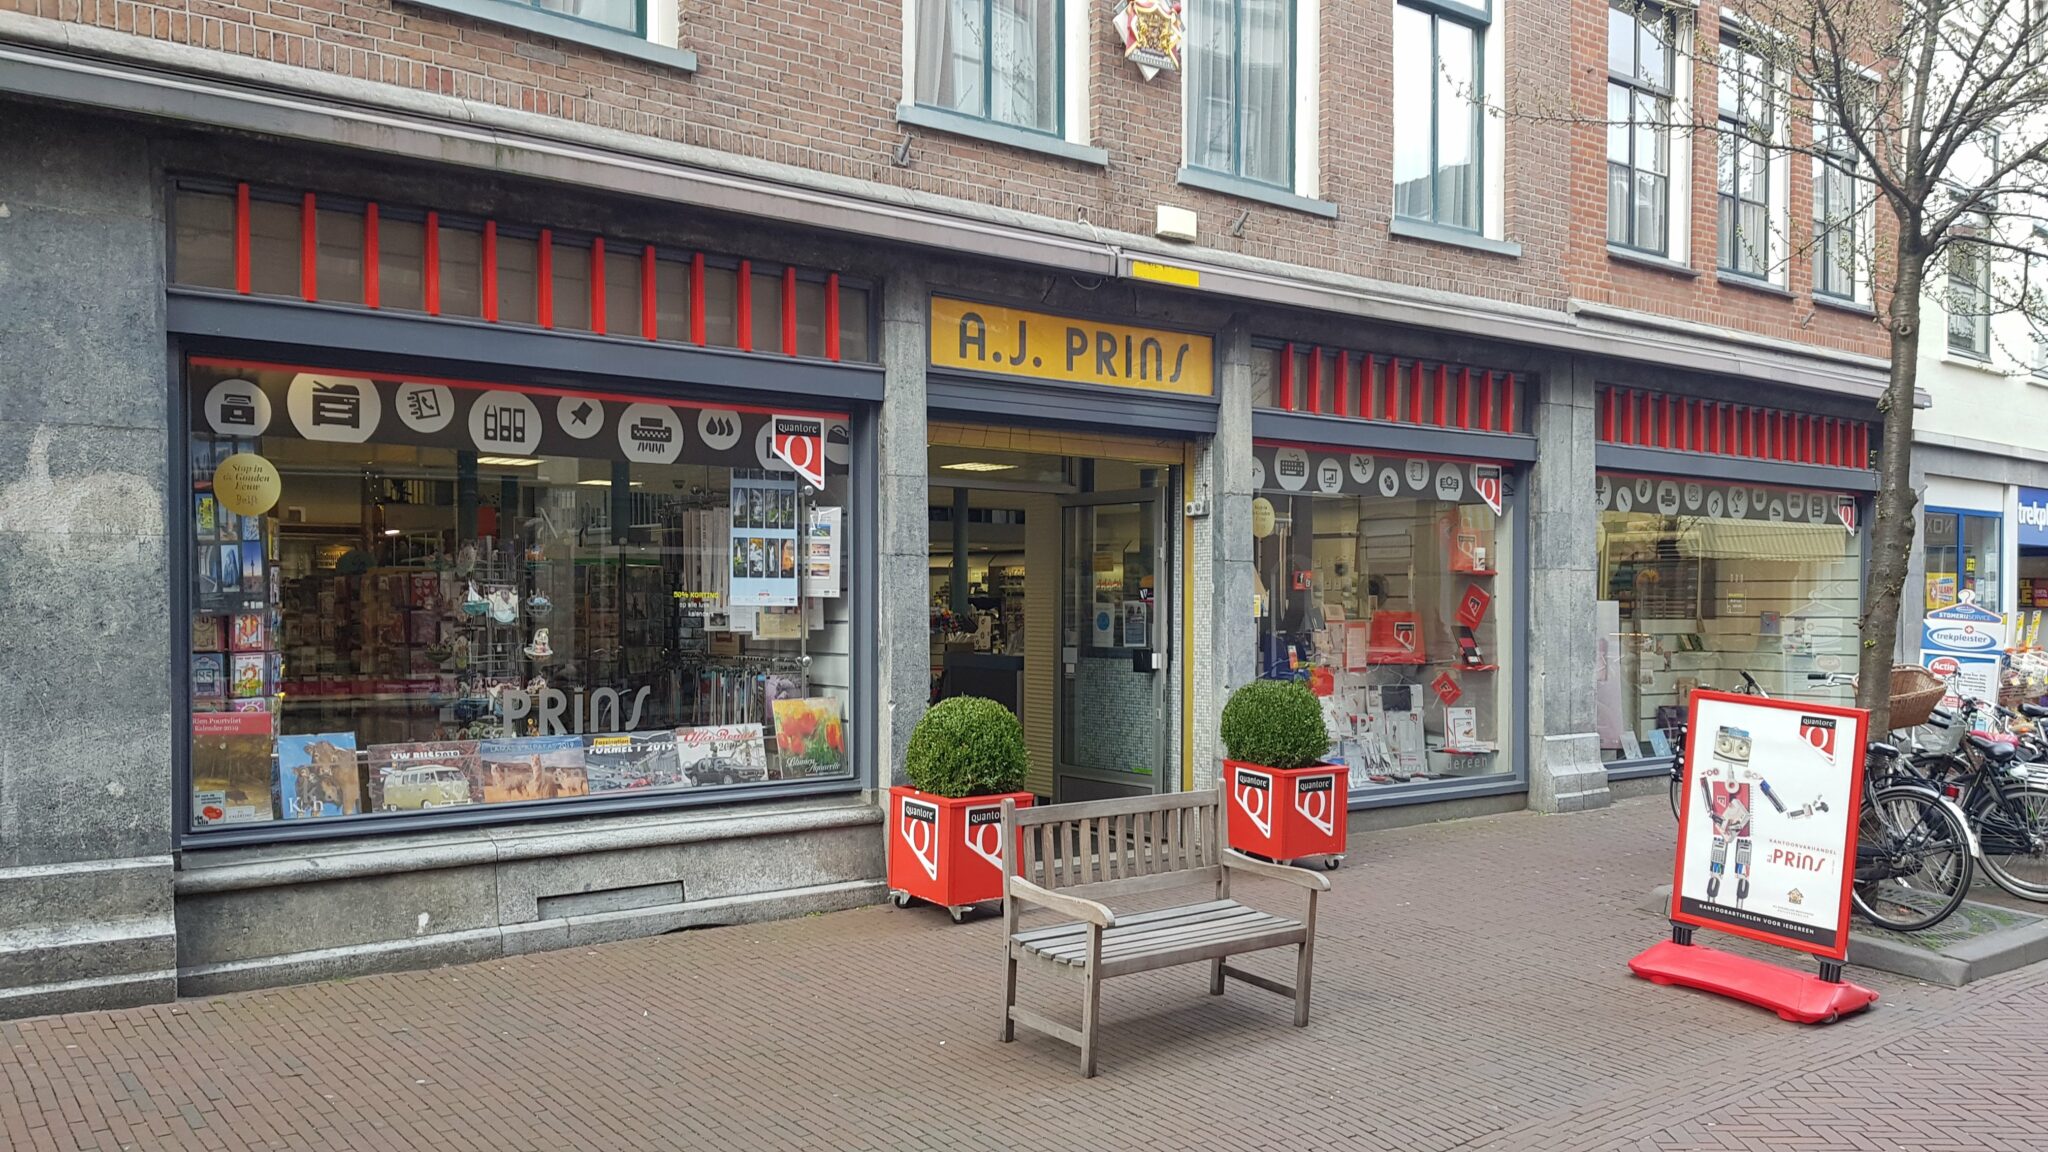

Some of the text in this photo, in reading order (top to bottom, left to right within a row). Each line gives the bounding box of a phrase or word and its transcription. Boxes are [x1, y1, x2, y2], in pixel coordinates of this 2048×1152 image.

[959, 312, 1042, 368] A.J.
[778, 423, 818, 433] quantore
[1936, 632, 1988, 643] trekpleister
[1802, 718, 1833, 727] quantore
[391, 751, 410, 760] VW
[1239, 775, 1267, 787] quantore
[1300, 780, 1330, 790] quantore
[905, 805, 933, 820] quantore
[971, 810, 1000, 823] quanto
[1699, 903, 1761, 922] KANTOORARTIKELEN
[1763, 918, 1781, 927] VOOR
[1783, 921, 1815, 935] IEDEREEN
